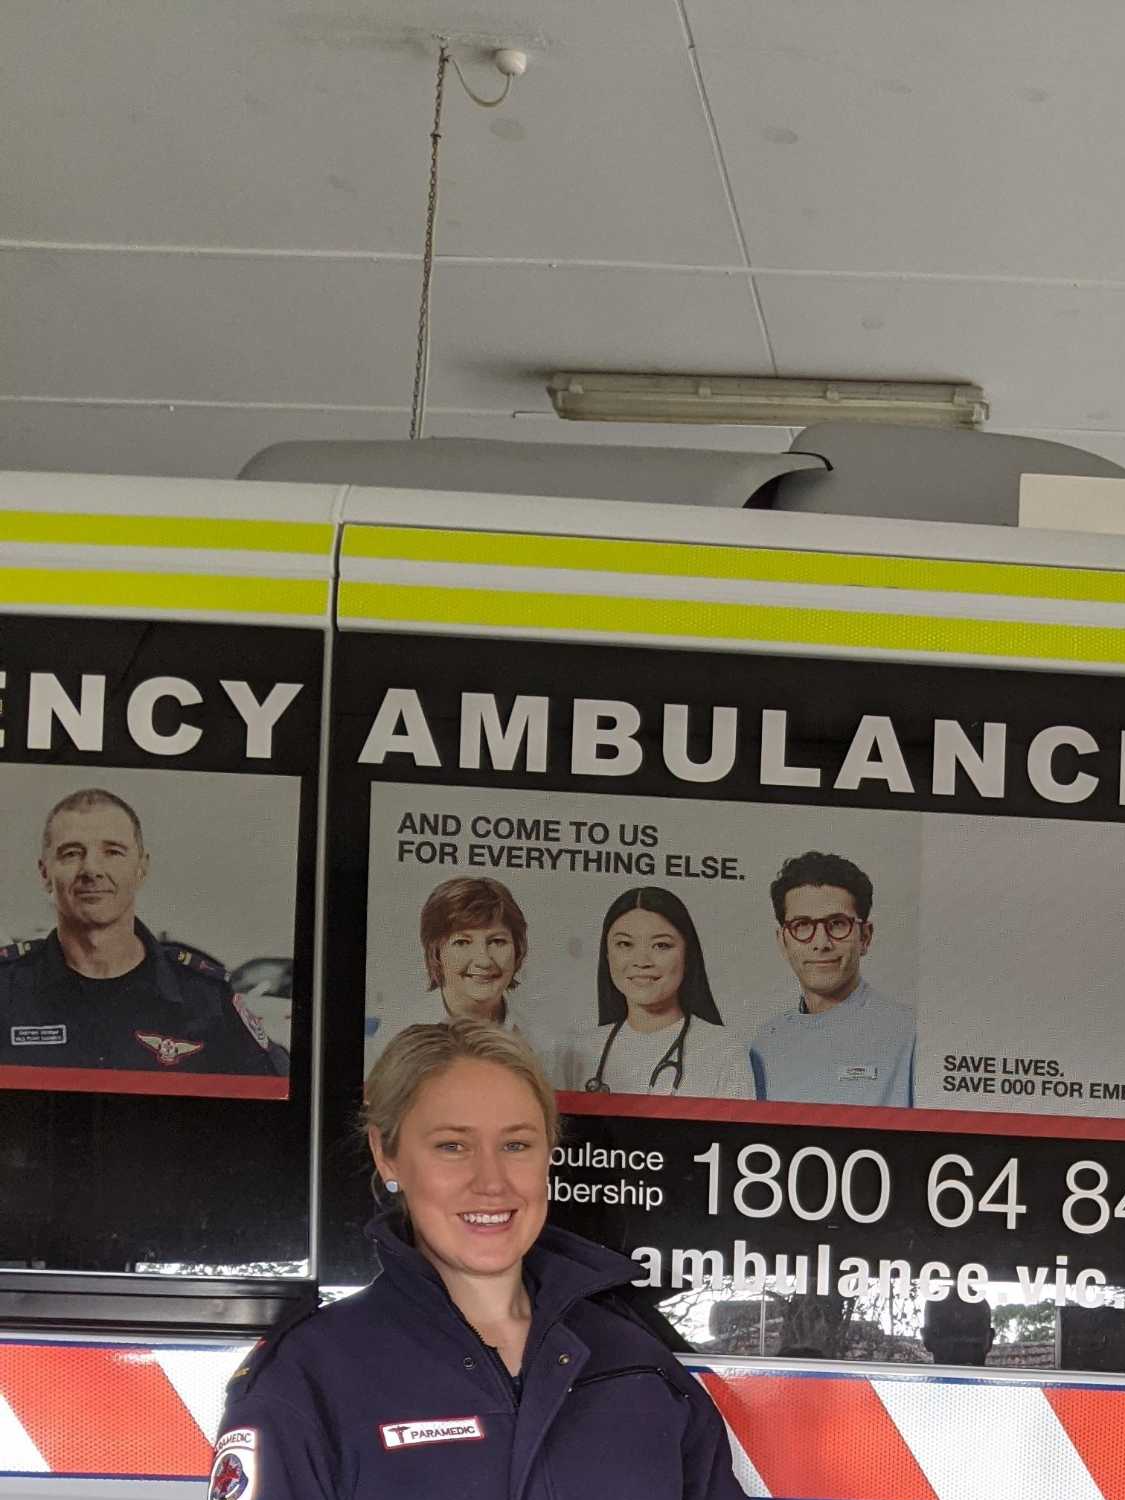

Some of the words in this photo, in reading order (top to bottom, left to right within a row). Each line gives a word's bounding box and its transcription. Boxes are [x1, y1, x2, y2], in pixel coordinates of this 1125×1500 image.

[0, 671, 304, 759] NCY
[397, 812, 461, 837] AND
[471, 817, 561, 842] COME
[569, 821, 610, 846] TO
[619, 824, 659, 848] US
[398, 840, 458, 865] FOR
[468, 844, 656, 876] EVERYTHING
[665, 855, 746, 880] ELSE.
[943, 1055, 996, 1074] SAVE
[1002, 1058, 1065, 1077] LIVES.
[943, 1075, 996, 1094] SAVE
[1041, 1080, 1083, 1098] FOR
[693, 1142, 891, 1223] 1800
[927, 1154, 1027, 1230] 64
[410, 1425, 475, 1440] PARAMEDIC
